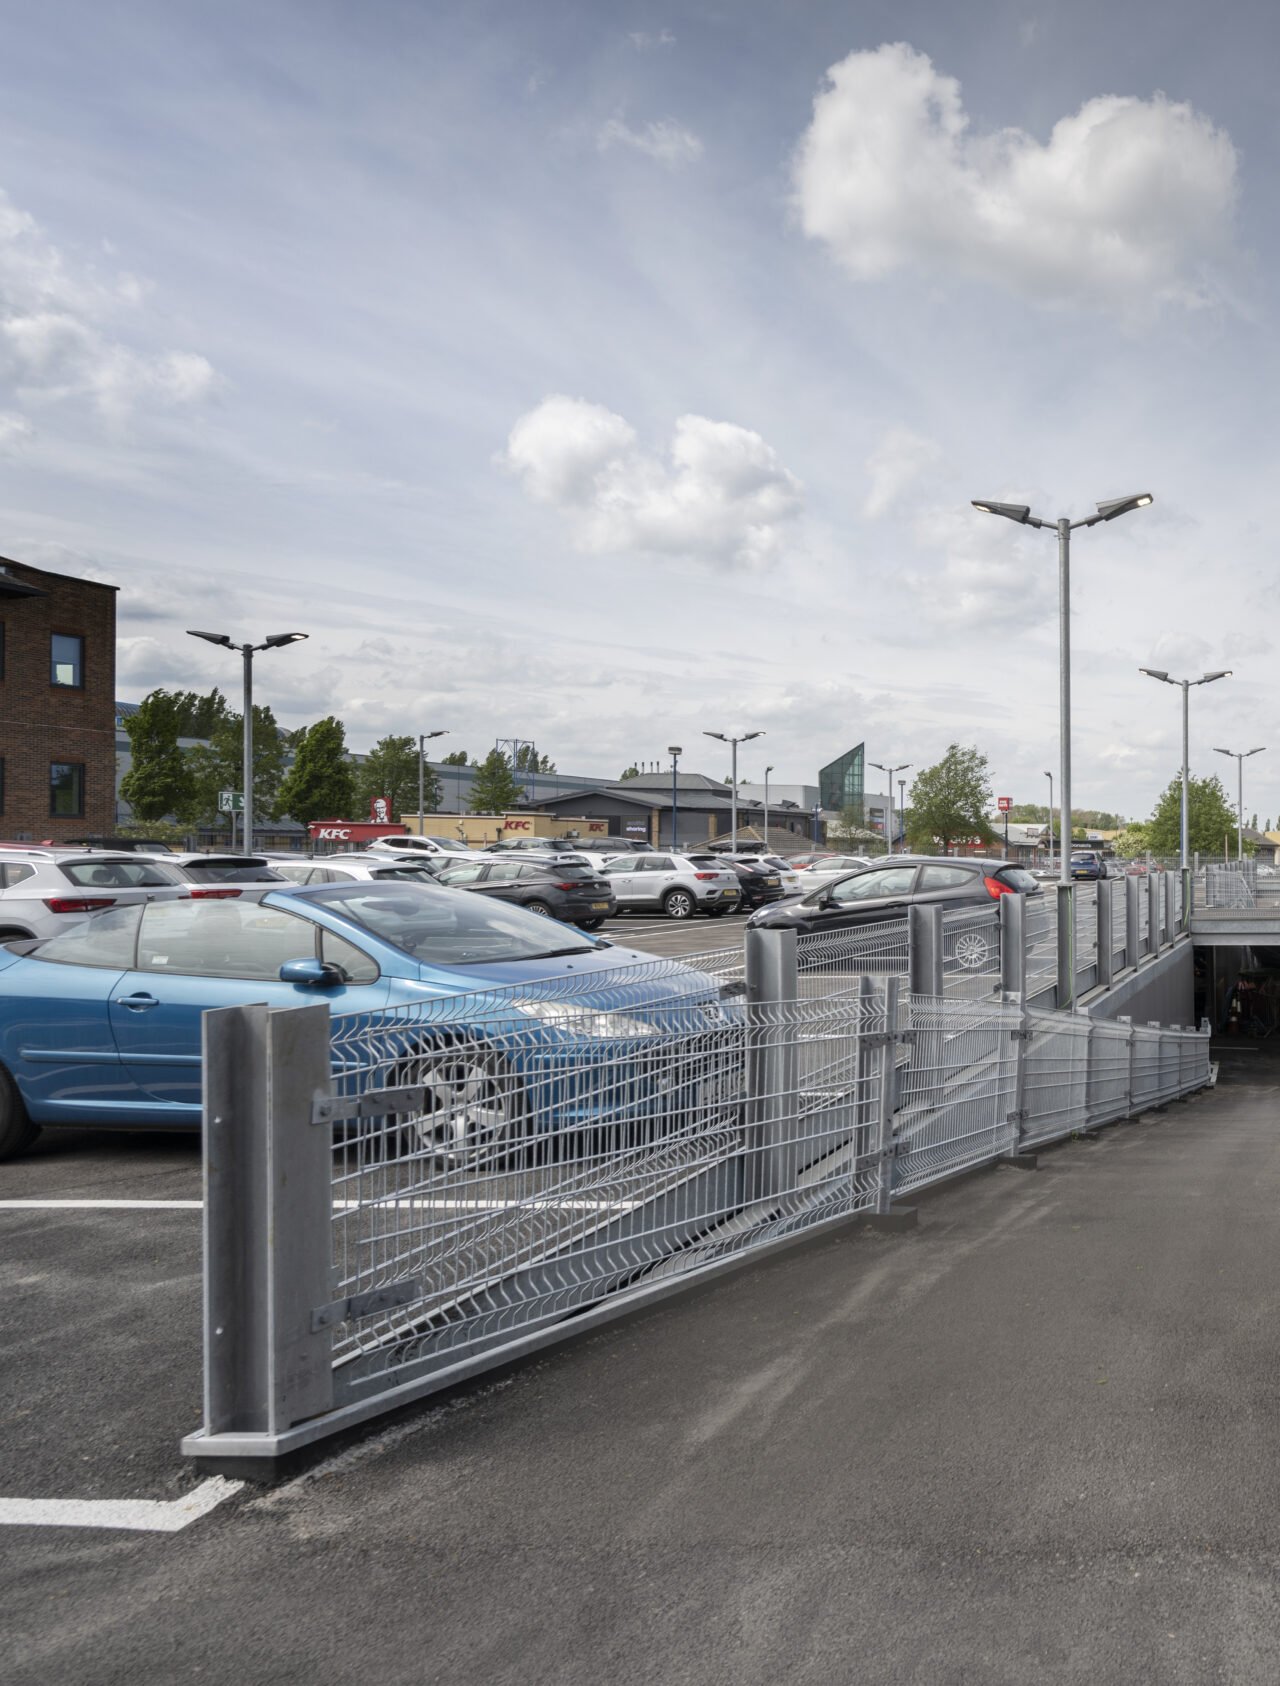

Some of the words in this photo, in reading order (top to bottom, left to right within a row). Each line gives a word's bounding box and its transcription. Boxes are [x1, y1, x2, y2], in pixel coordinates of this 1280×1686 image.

[503, 821, 530, 831] KFC
[589, 823, 604, 832] KFC
[319, 828, 350, 840] KFC
